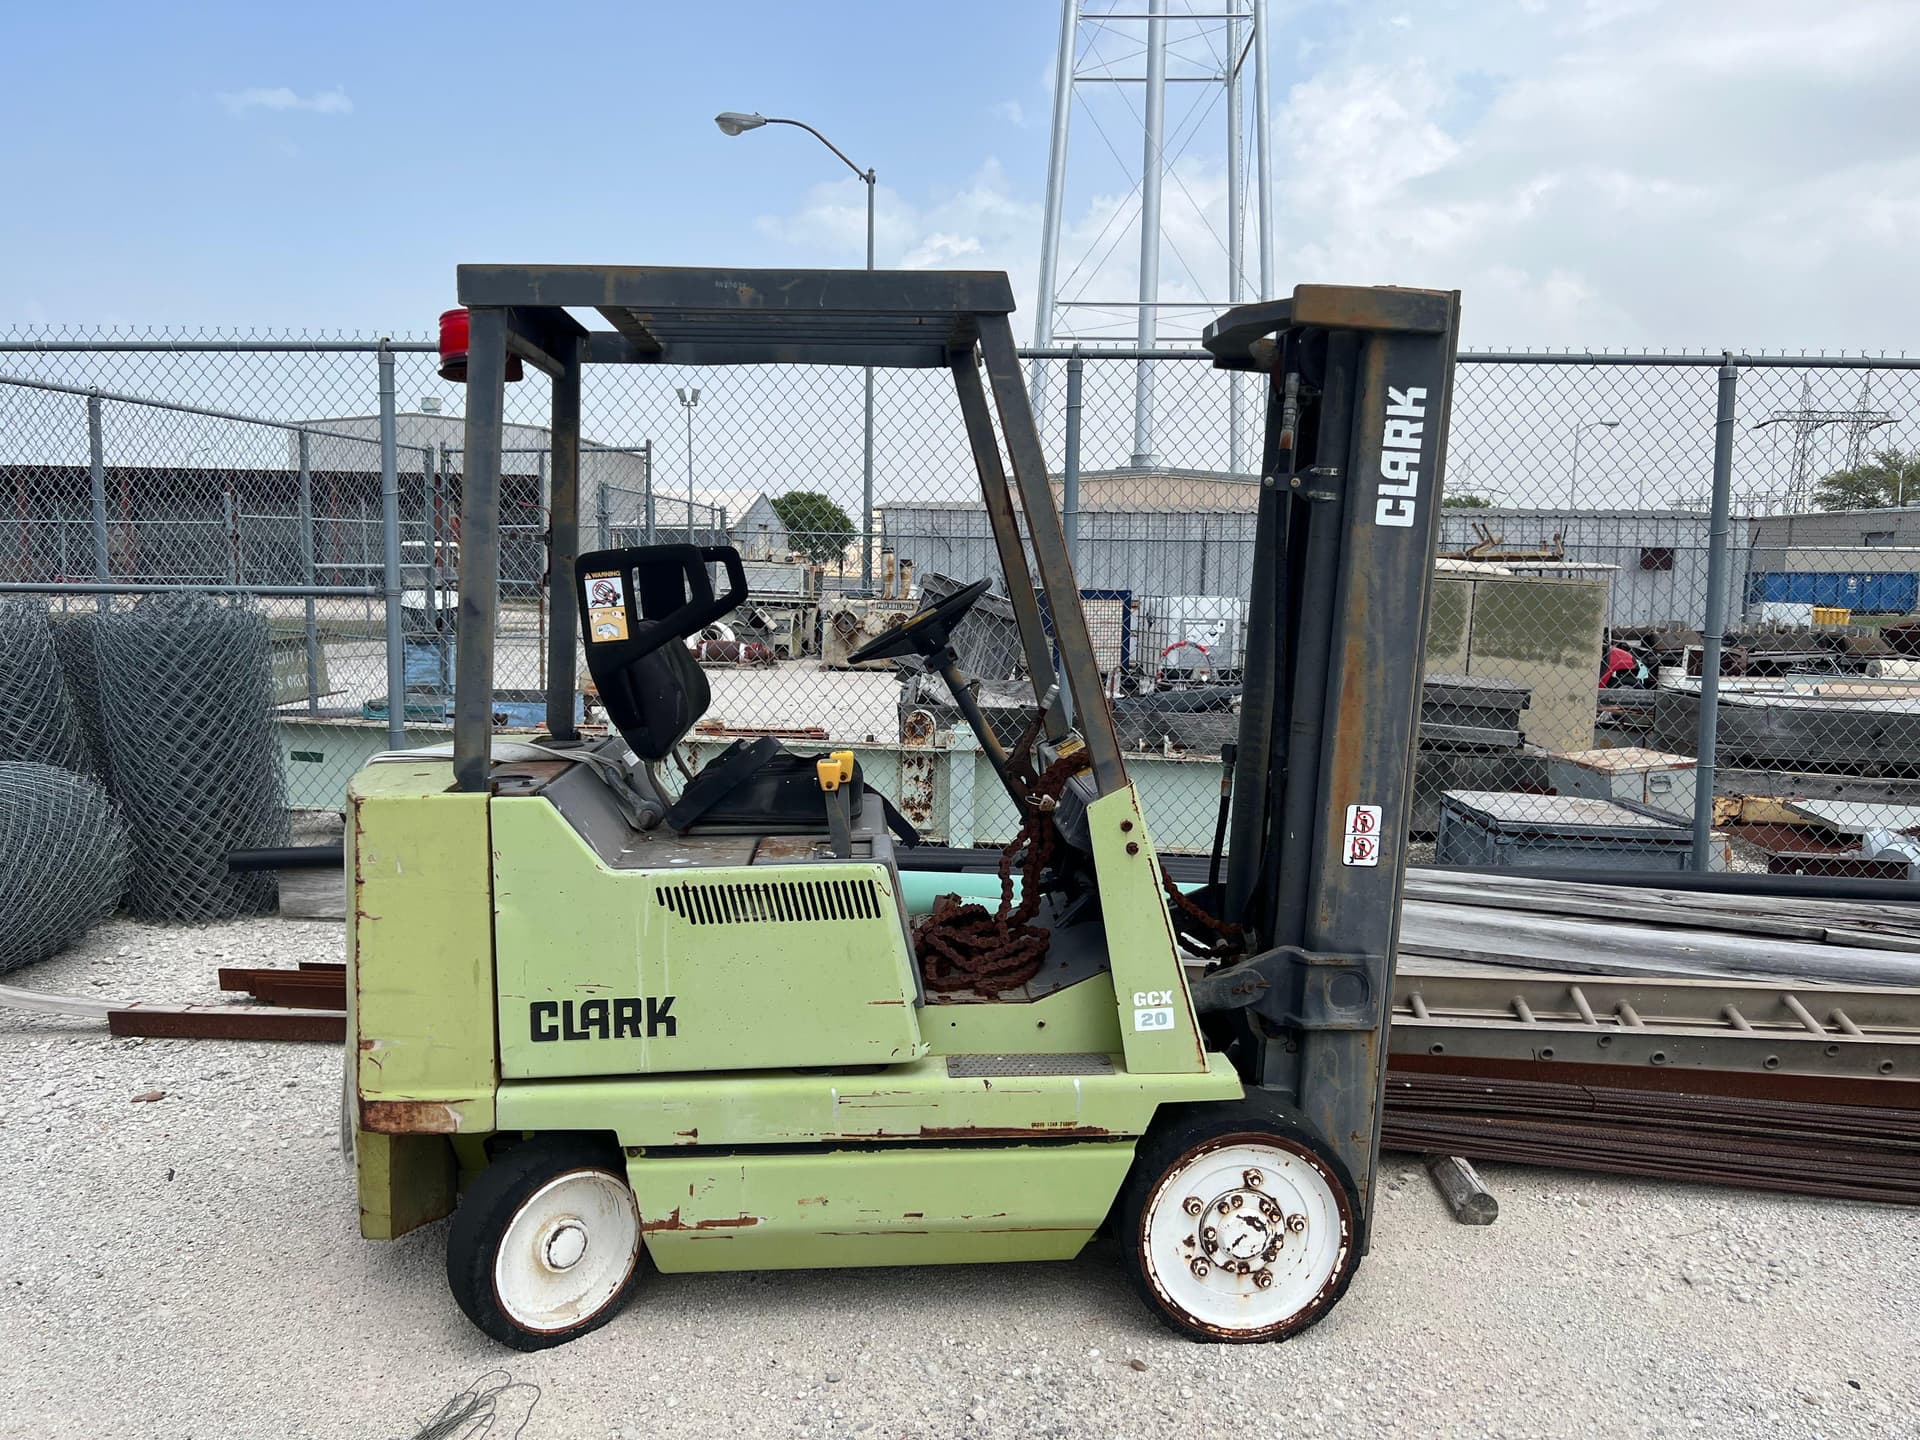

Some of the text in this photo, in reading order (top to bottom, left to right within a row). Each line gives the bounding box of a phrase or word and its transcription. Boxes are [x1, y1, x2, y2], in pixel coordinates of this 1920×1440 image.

[1375, 386, 1427, 527] CLARK
[591, 570, 621, 578] WARNING
[1133, 990, 1173, 1006] GCX
[530, 996, 677, 1042] CLARK
[1141, 1012, 1168, 1027] 20
